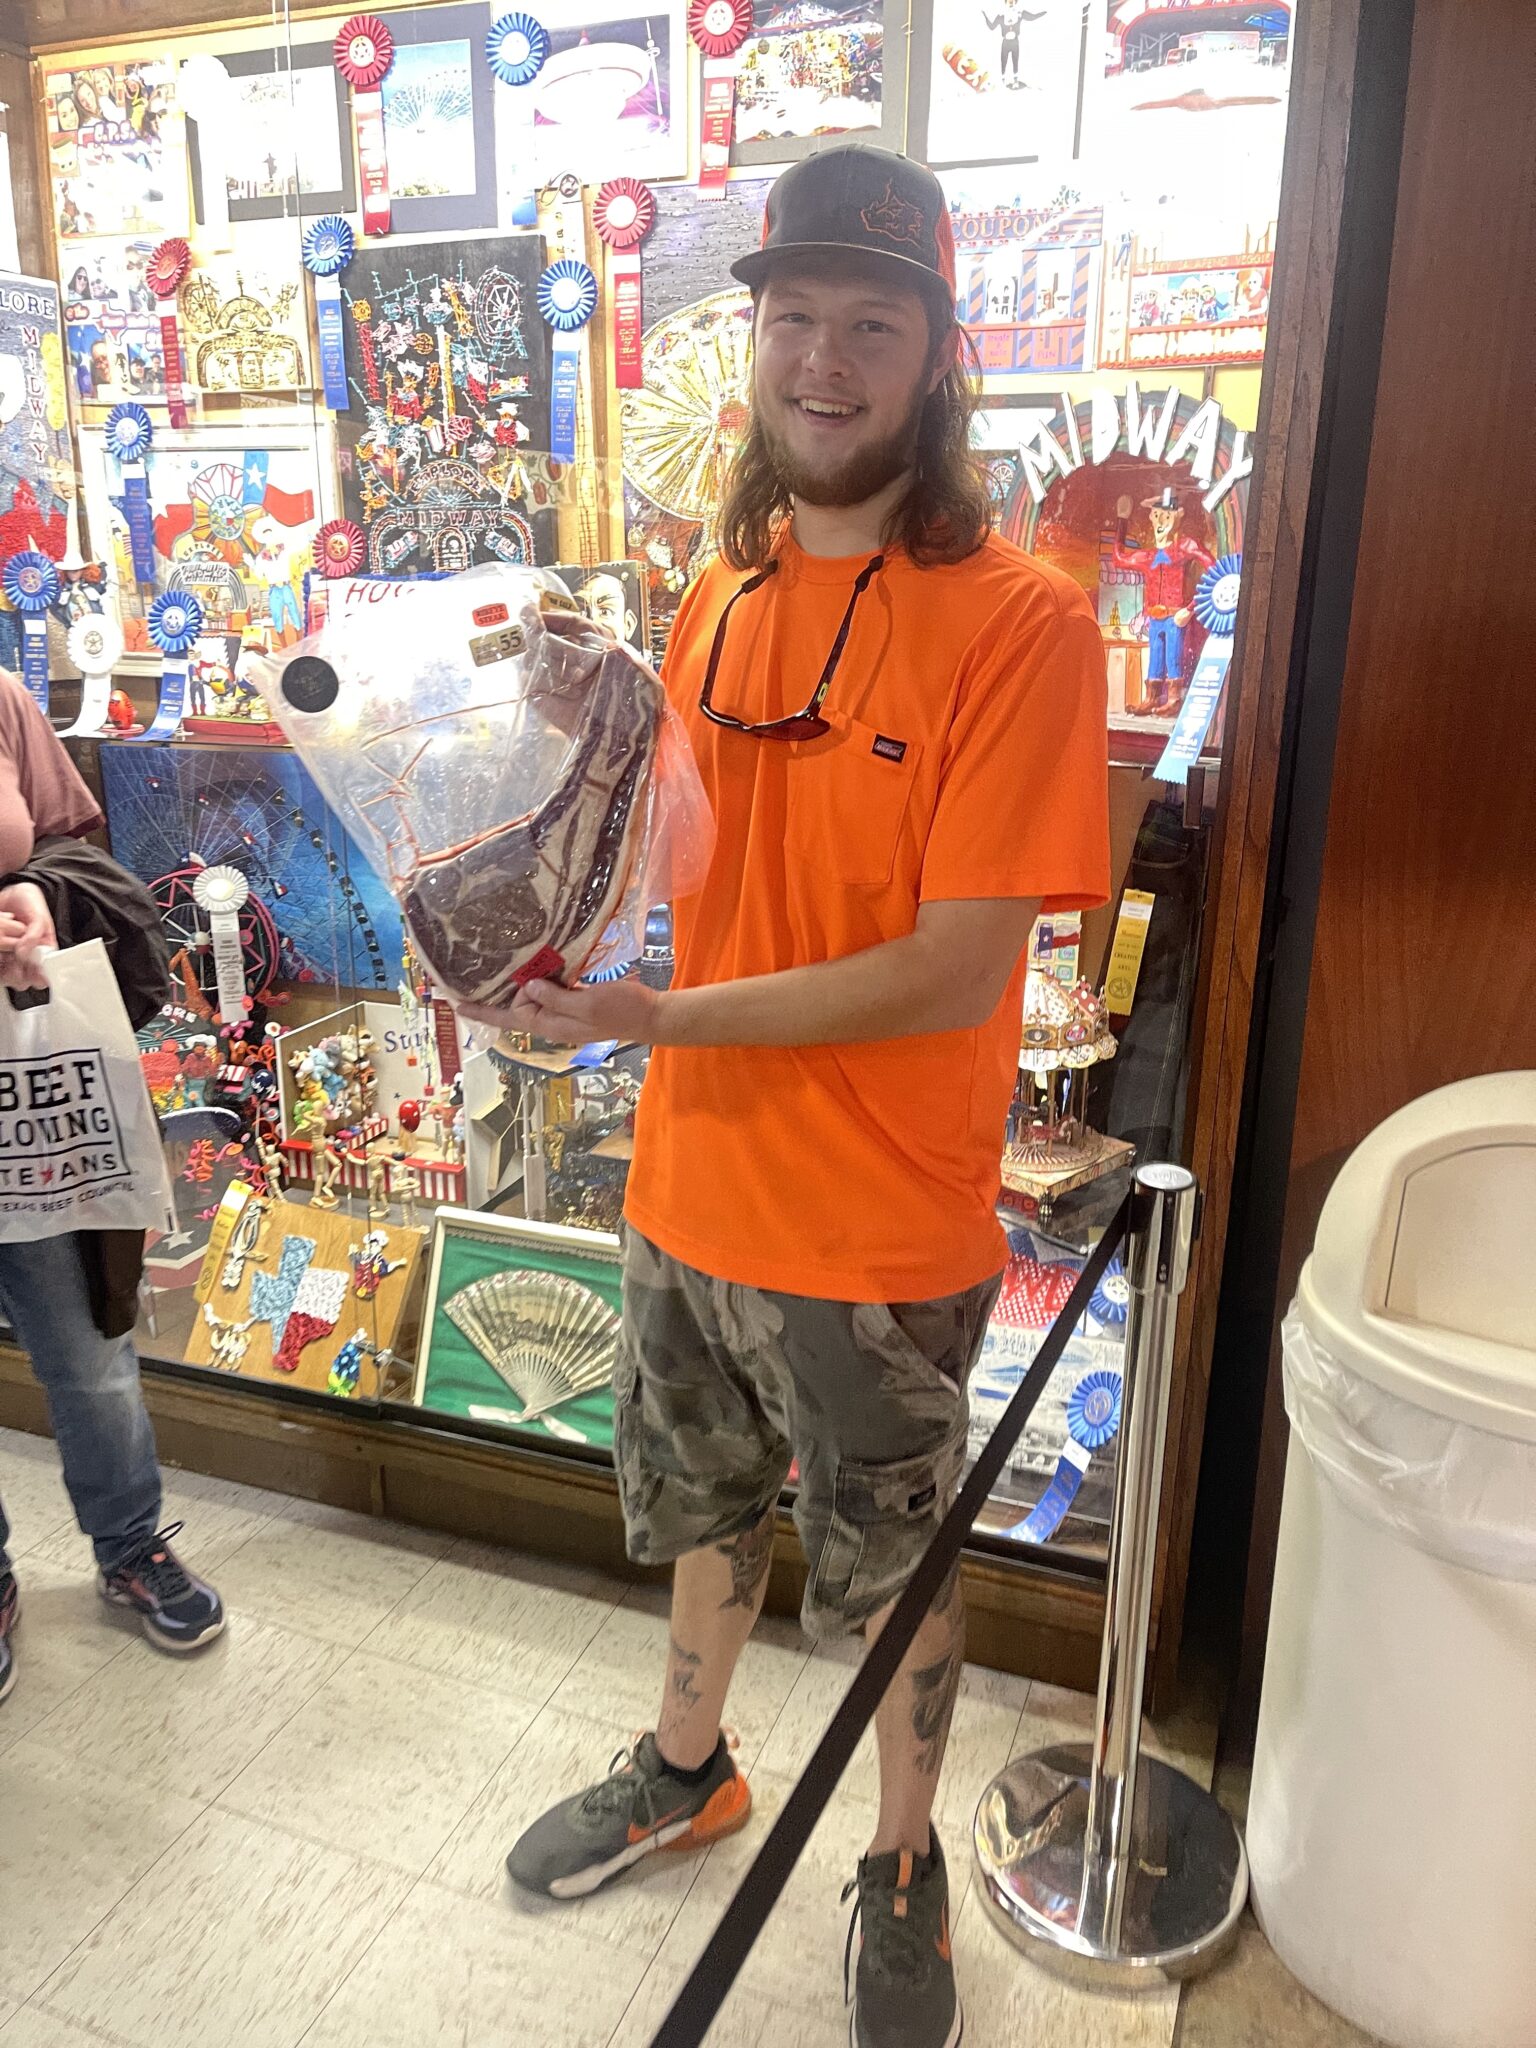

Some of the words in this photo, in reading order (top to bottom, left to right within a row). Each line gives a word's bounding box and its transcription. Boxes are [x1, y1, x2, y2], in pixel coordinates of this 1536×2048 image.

[22, 326, 47, 462] MIDWAY
[1019, 380, 1254, 513] MIDWAY
[398, 509, 500, 527] MIDWAY
[500, 630, 521, 652] 55
[0, 1060, 96, 1112] BEEF
[0, 1106, 110, 1148] LOVING
[40, 1196, 73, 1213] BEEF
